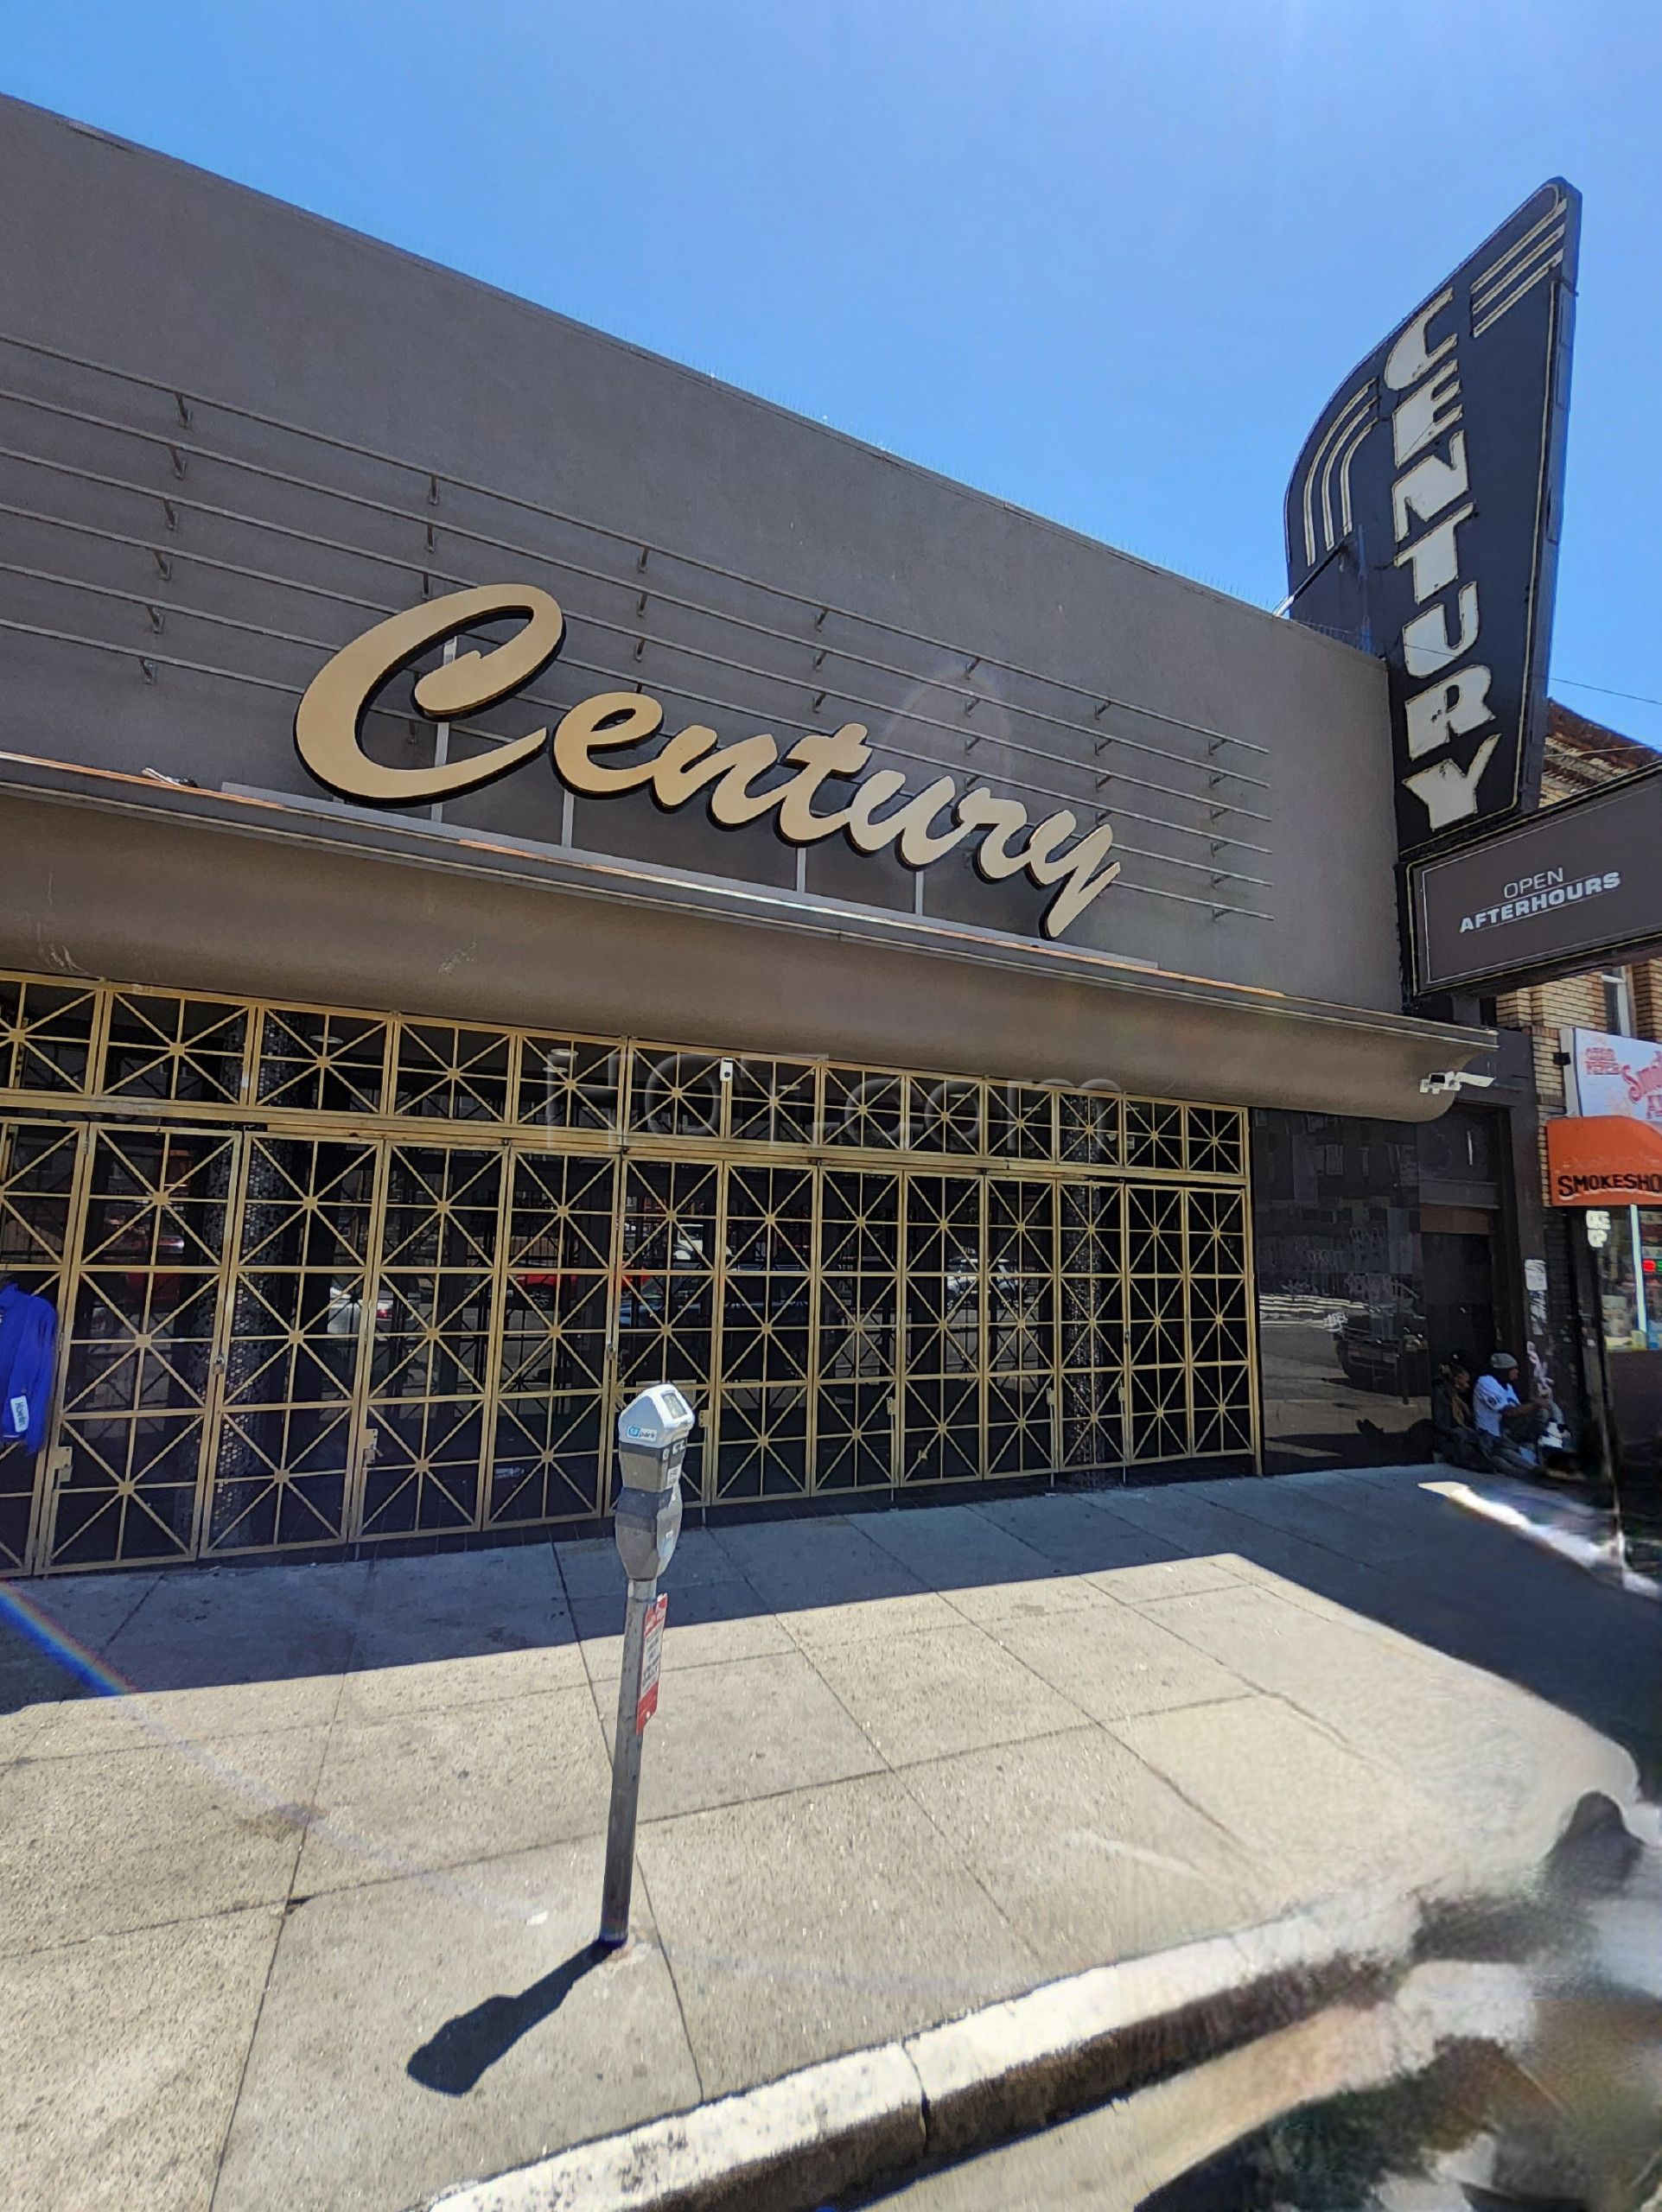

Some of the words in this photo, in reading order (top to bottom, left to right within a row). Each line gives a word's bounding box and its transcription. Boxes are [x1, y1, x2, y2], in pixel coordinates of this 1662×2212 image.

[1383, 287, 1501, 831] CENTURY
[294, 583, 1121, 940] Century
[1459, 871, 1621, 933] AFTERHOURS
[1504, 868, 1563, 899] OPEN
